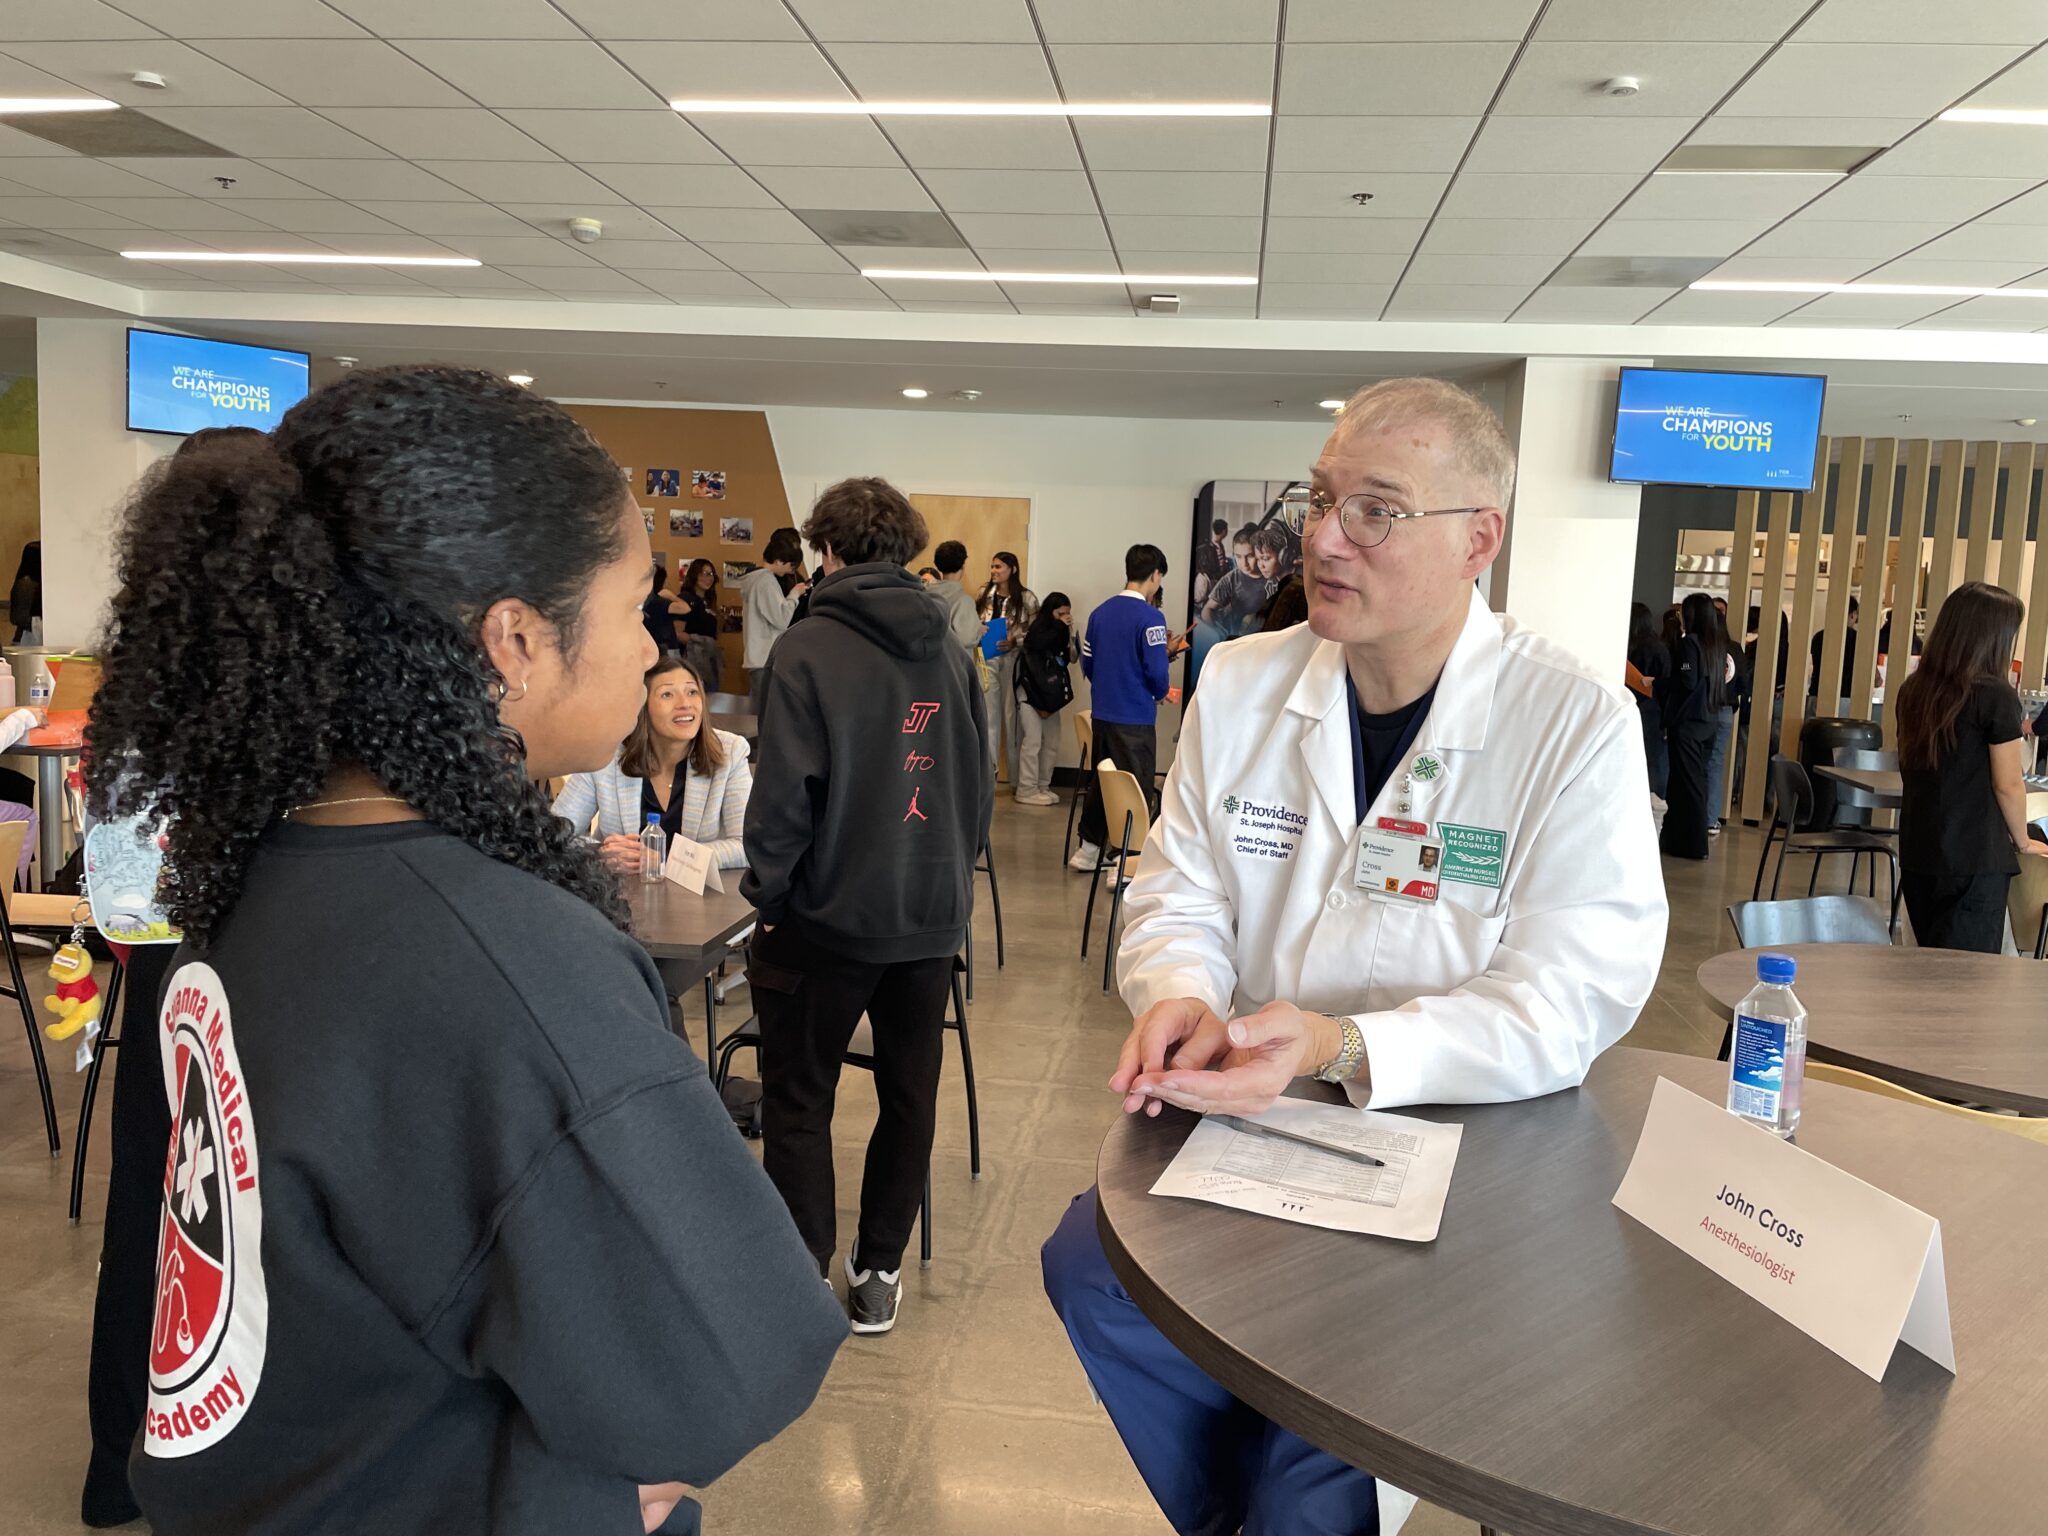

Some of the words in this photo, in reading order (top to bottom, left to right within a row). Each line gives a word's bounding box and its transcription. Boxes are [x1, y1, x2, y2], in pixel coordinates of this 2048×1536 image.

[172, 365, 191, 378] WE
[193, 368, 215, 380] ARE
[171, 376, 271, 400] CHAMPIONS
[190, 390, 207, 400] FOR
[209, 393, 271, 413] YOUTH
[1664, 405, 1684, 416] WE
[1686, 406, 1711, 418] ARE
[1662, 417, 1773, 436] CHAMPIONS
[1681, 432, 1700, 442] FOR
[1702, 434, 1772, 453] YOUTH
[1241, 800, 1309, 826] Providence
[1240, 817, 1250, 826] St.
[1251, 819, 1276, 831] Joseph
[1276, 823, 1303, 836] Hospital
[1233, 834, 1253, 843] John
[1254, 837, 1280, 849] Cross,
[1280, 841, 1294, 851] MD
[1447, 839, 1498, 852] RECOGNIZED
[1449, 830, 1499, 845] MAGNET
[1236, 844, 1258, 855] Chief
[1259, 848, 1268, 856] of
[1269, 849, 1289, 860] Staff
[1361, 860, 1382, 871] Cross
[1444, 863, 1473, 873] AMERICAN
[1473, 868, 1496, 877] NURSES
[1420, 885, 1435, 897] MD
[206, 1007, 256, 1193] Medical
[1716, 1184, 1755, 1220] John
[1758, 1208, 1804, 1248] Cross
[1699, 1215, 1796, 1285] Anesthesiologist
[147, 1365, 246, 1441] cademy
